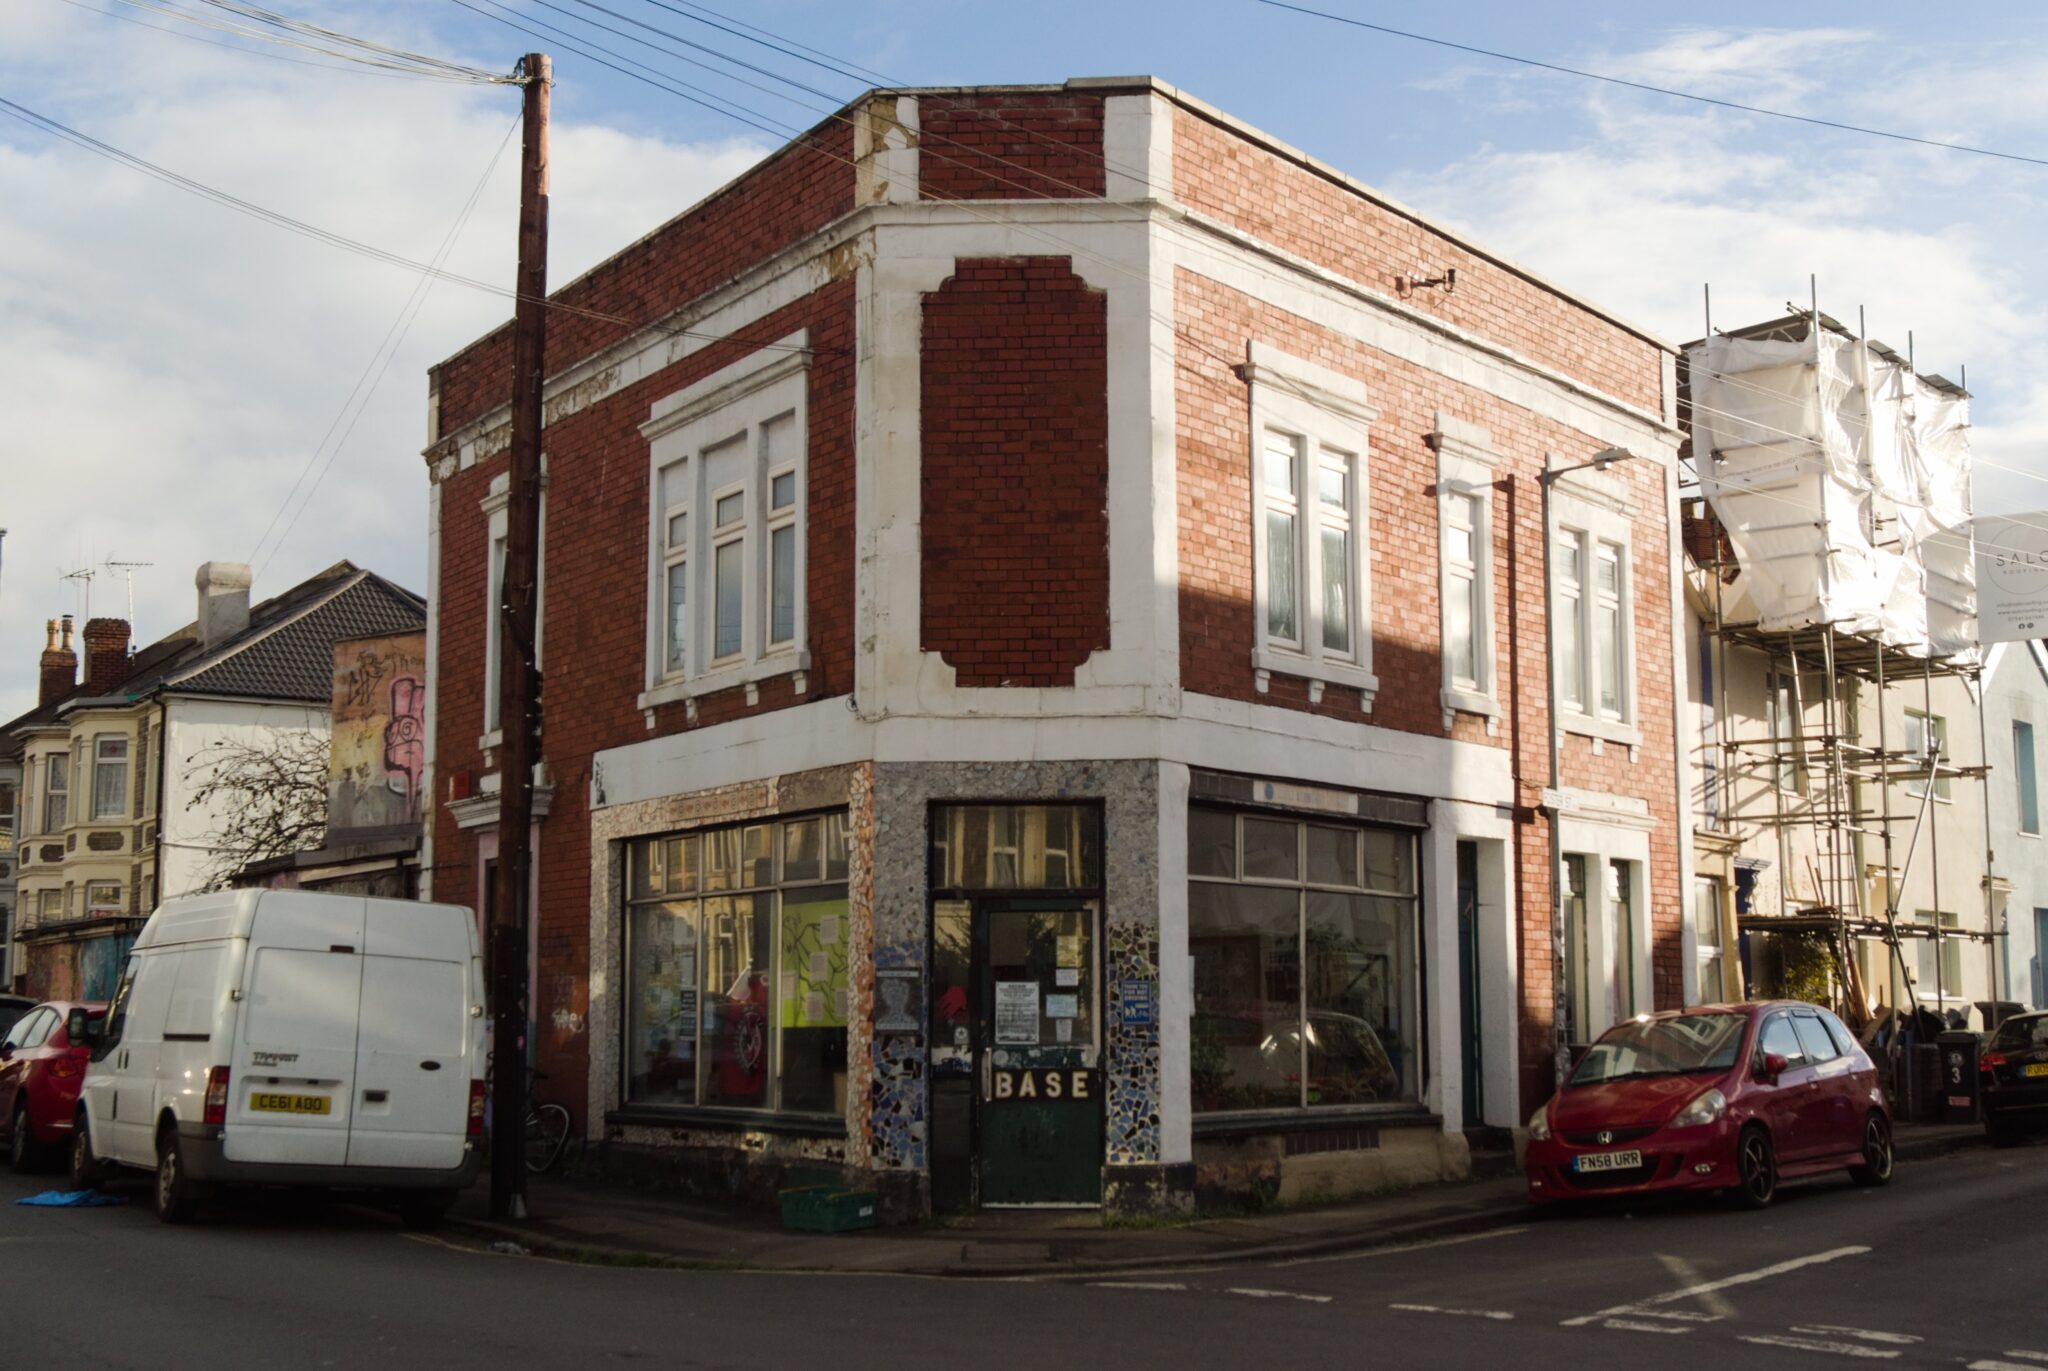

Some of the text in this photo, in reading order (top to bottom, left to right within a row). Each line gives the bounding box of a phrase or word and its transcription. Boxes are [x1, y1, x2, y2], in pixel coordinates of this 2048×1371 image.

[1952, 1067, 1960, 1084] 3
[995, 1071, 1088, 1098] BASE
[259, 1095, 291, 1109] CE61
[1580, 1152, 1639, 1169] FN58 URR
